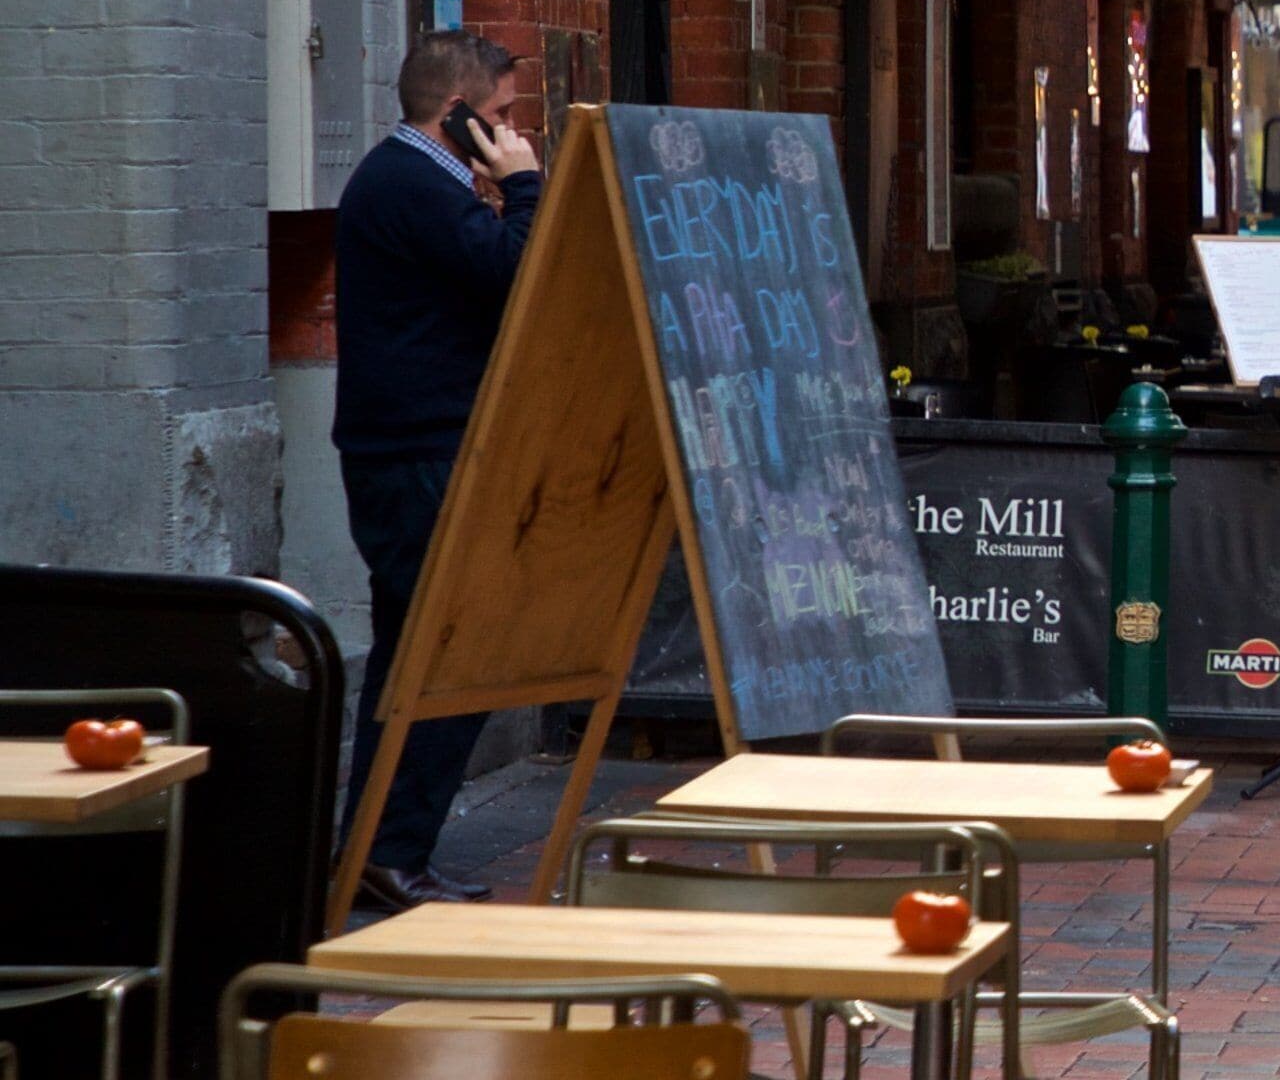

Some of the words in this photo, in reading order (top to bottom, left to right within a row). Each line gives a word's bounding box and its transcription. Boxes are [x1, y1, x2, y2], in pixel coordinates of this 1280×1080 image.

[634, 174, 798, 274] EVERYDAY
[660, 291, 688, 352] A
[756, 288, 821, 358] DAY
[976, 497, 1064, 537] Mill
[976, 539, 1064, 558] Restaurant
[928, 585, 1061, 624] harlie's
[1032, 627, 1060, 643] Bar
